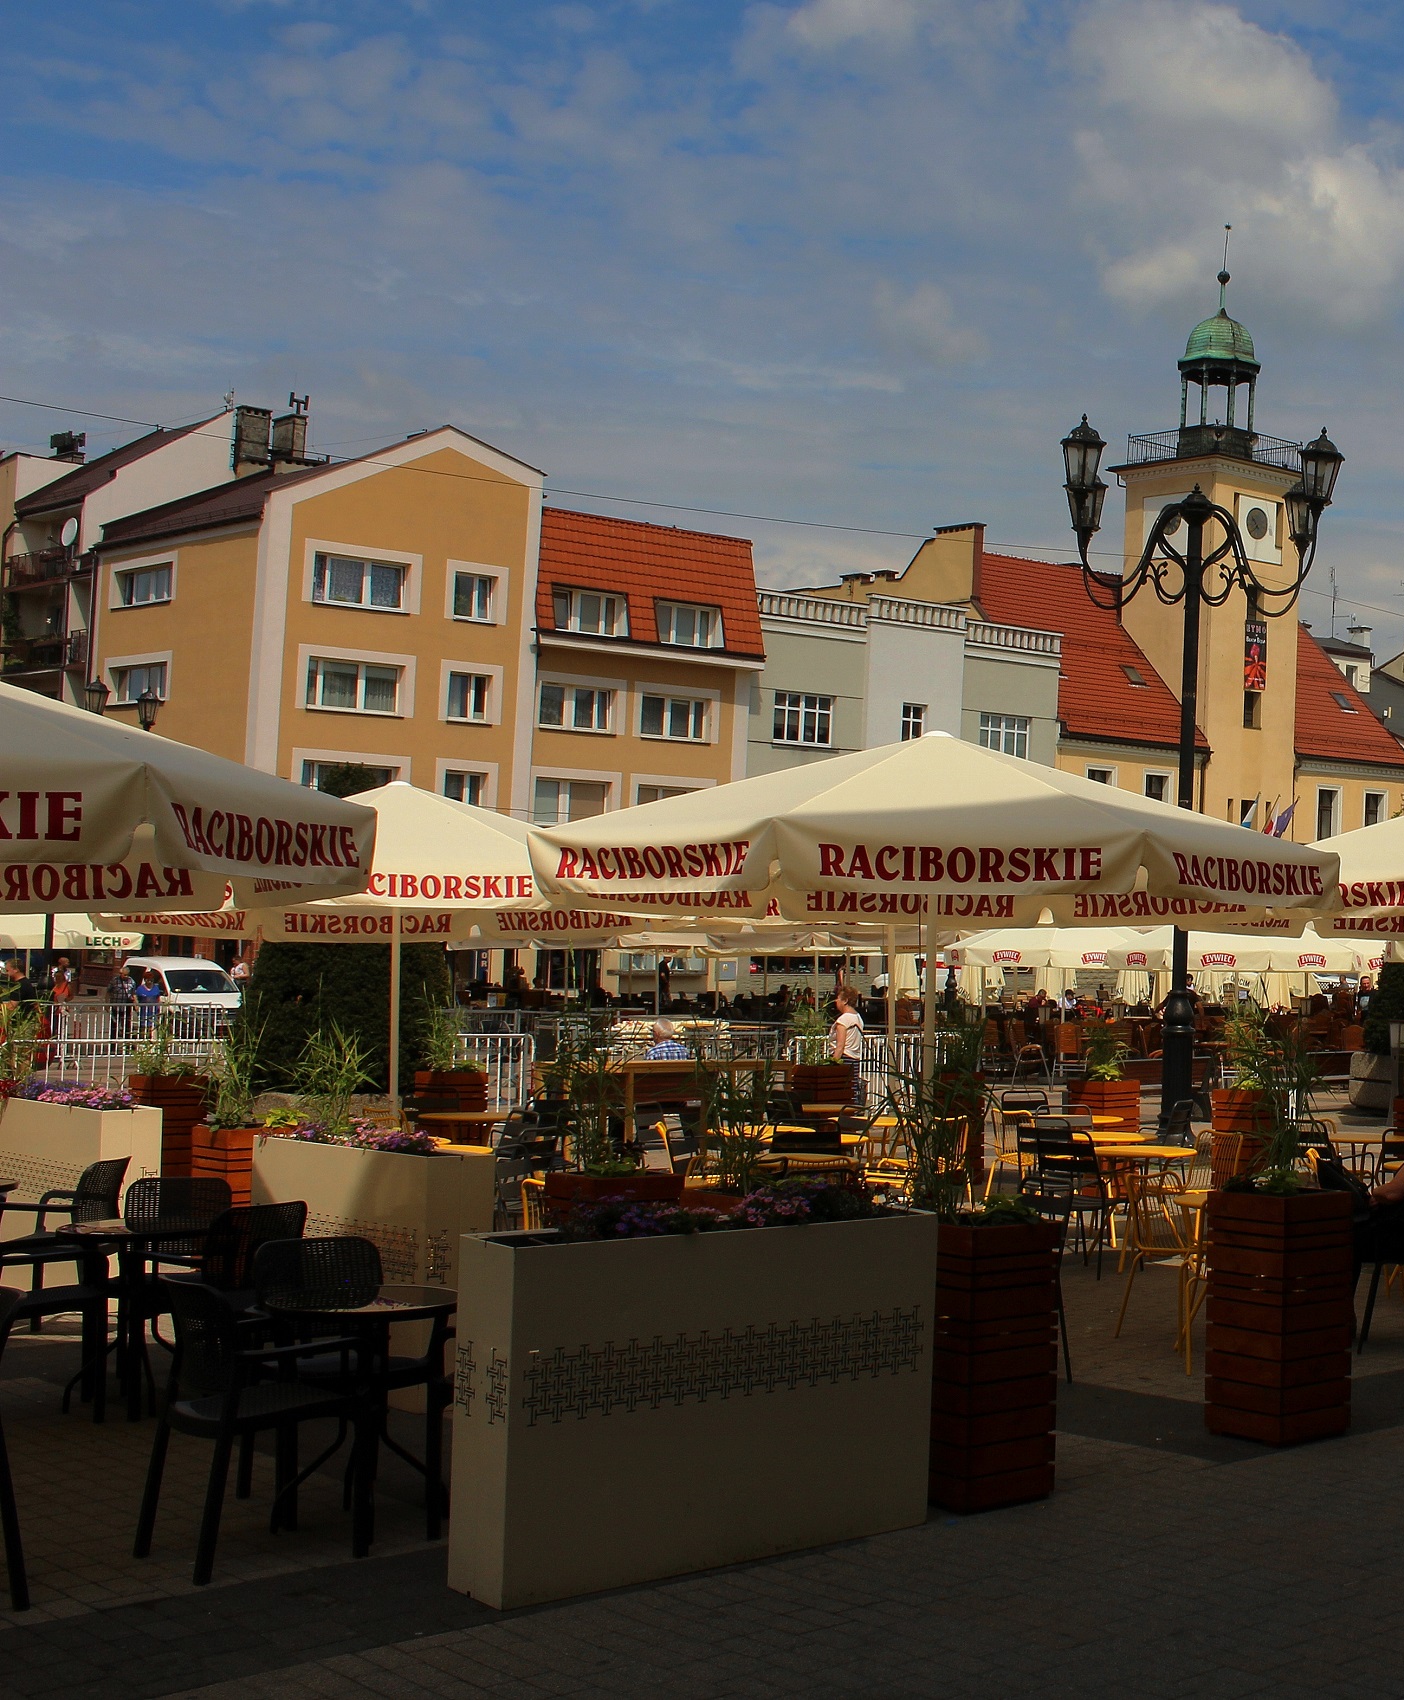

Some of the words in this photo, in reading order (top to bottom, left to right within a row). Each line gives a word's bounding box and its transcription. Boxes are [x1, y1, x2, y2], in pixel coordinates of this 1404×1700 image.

[171, 802, 360, 868] RACIBORSKIE
[555, 841, 749, 879] RACIBORSKIE
[818, 843, 1102, 883] RACIBORSKIE
[1172, 852, 1324, 896] RACIBORSKIE
[364, 873, 533, 899] CIBORSKIE
[86, 936, 121, 947] LECH
[1084, 952, 1106, 962] ŻYWIE
[1204, 953, 1234, 964] ŻYWIEC
